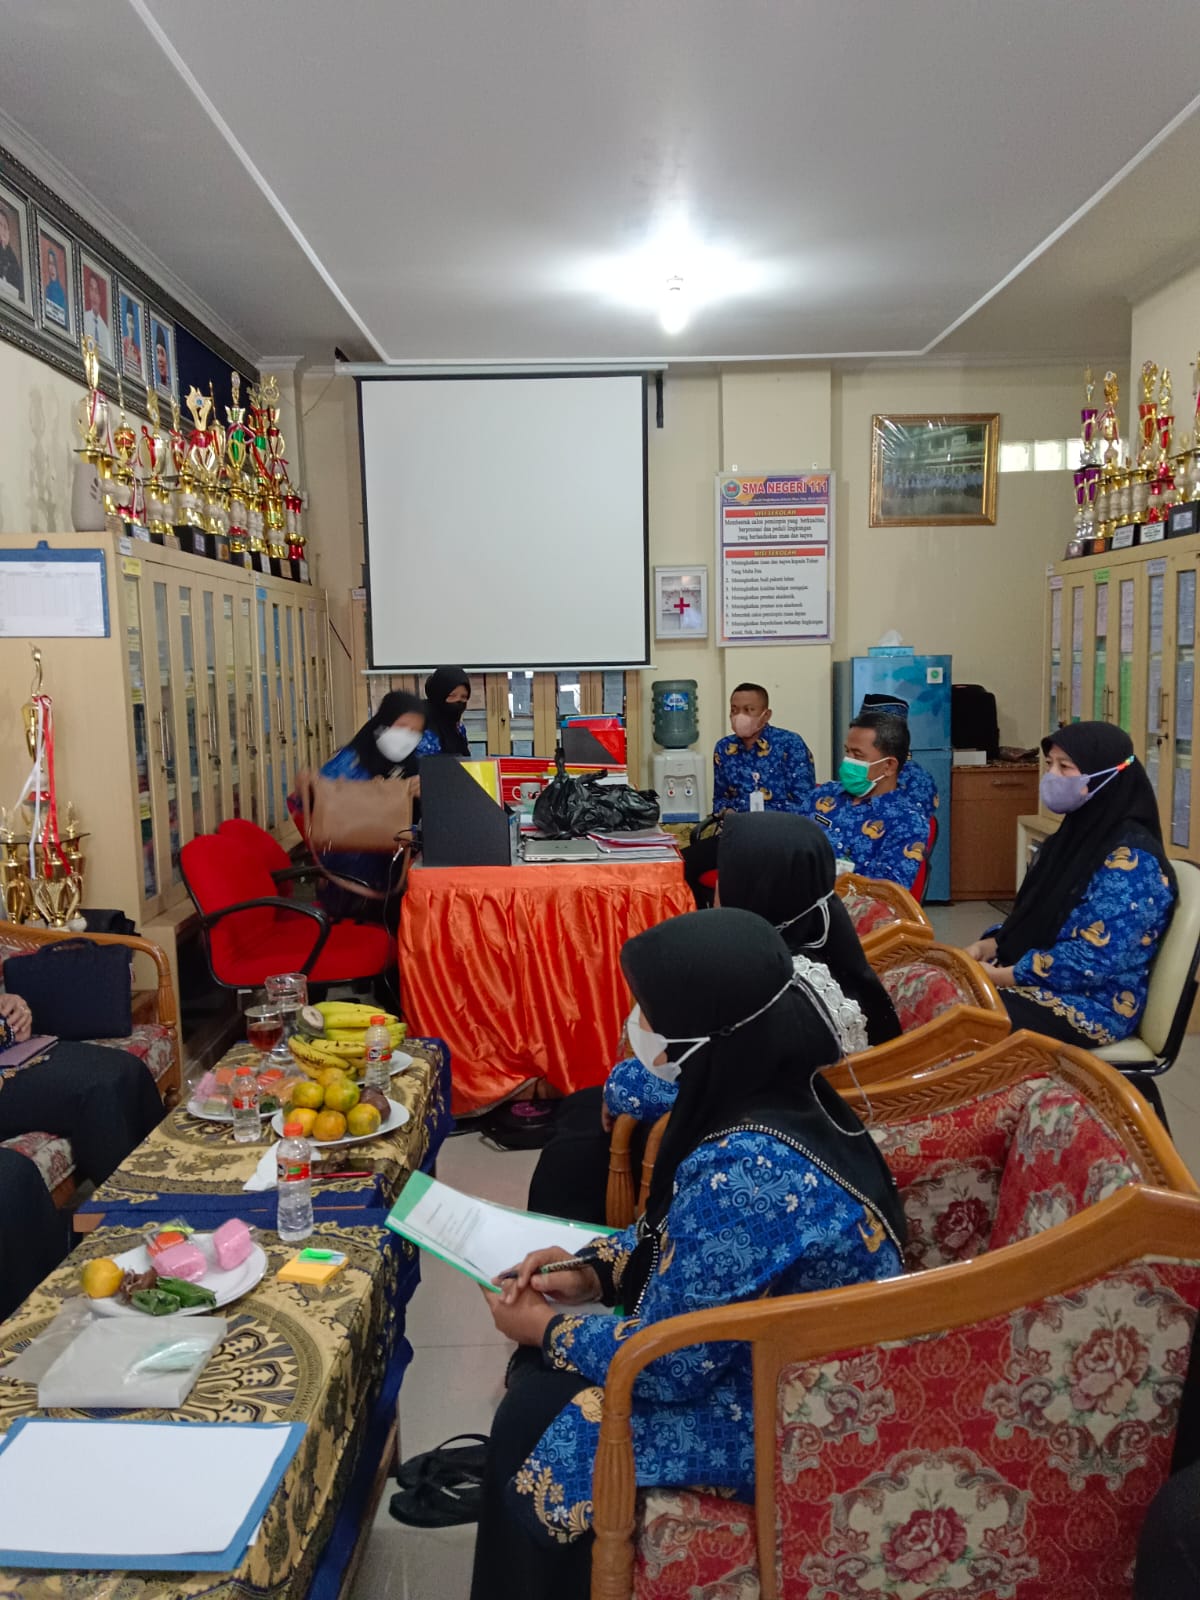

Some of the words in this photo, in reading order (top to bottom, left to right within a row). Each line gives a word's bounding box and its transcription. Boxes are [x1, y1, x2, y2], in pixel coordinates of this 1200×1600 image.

[742, 482, 764, 494] SMA
[767, 481, 806, 493] NEGERI
[810, 480, 827, 493] 111
